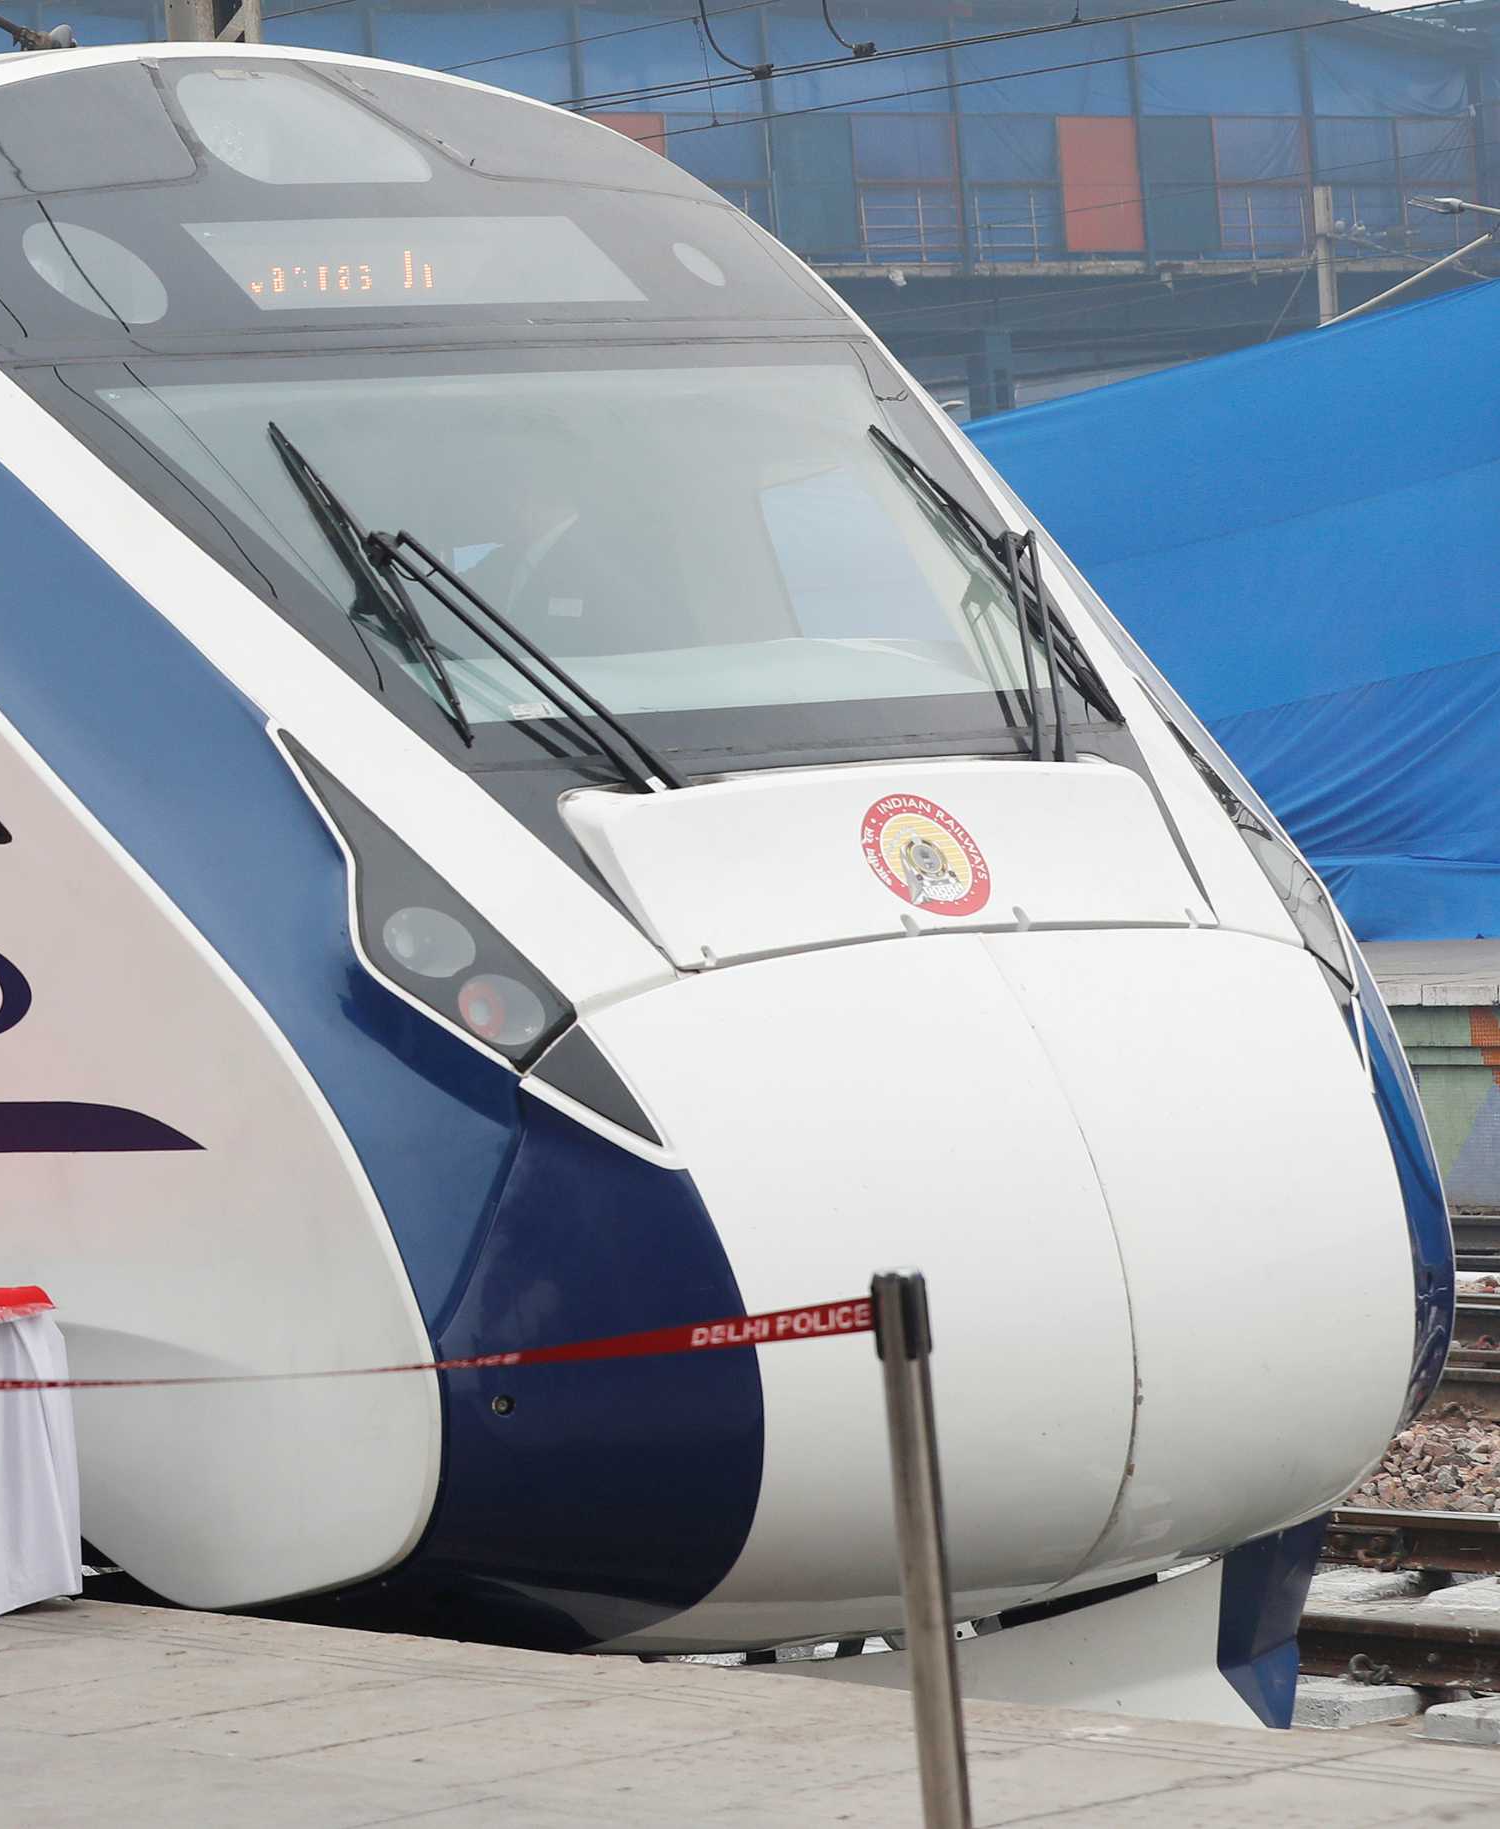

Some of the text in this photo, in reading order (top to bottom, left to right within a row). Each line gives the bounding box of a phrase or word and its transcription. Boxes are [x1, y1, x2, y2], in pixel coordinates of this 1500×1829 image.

[877, 797, 988, 880] INDIAN RAILWAYS
[690, 1302, 870, 1347] DELHI POLICE
